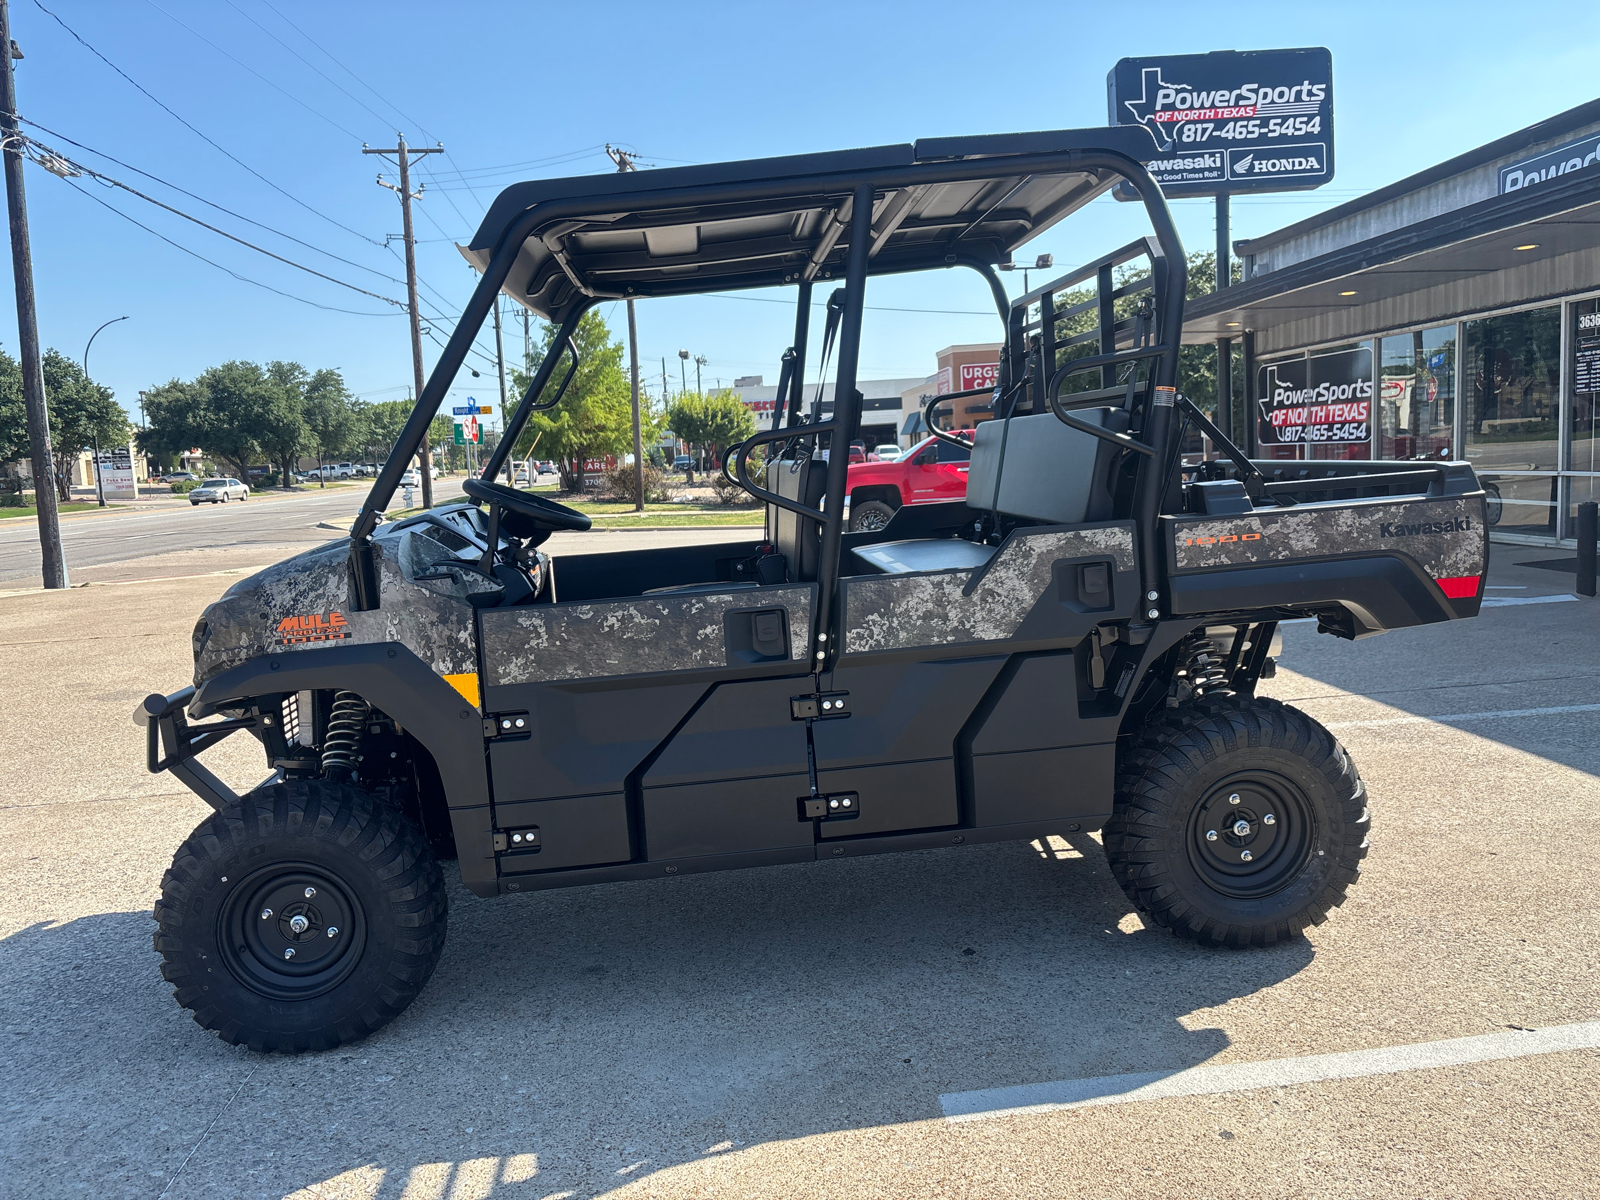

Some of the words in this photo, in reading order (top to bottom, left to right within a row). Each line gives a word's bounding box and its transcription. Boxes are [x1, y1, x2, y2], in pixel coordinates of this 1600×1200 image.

[1155, 80, 1326, 110] PowerSports
[1155, 112, 1173, 121] OF
[1173, 109, 1215, 120] NORTH
[1217, 106, 1254, 118] TEXAS
[1182, 116, 1321, 142] 817-465-5454
[1147, 153, 1221, 171] awasaki
[1253, 157, 1320, 173] HONDA
[1580, 314, 1600, 328] 3636
[1272, 409, 1286, 425] OF
[1328, 402, 1367, 422] TEXAS
[584, 462, 606, 470] ARE
[1380, 515, 1471, 538] Kawasaki
[1186, 533, 1260, 546] 1000
[276, 612, 348, 632] MULE
